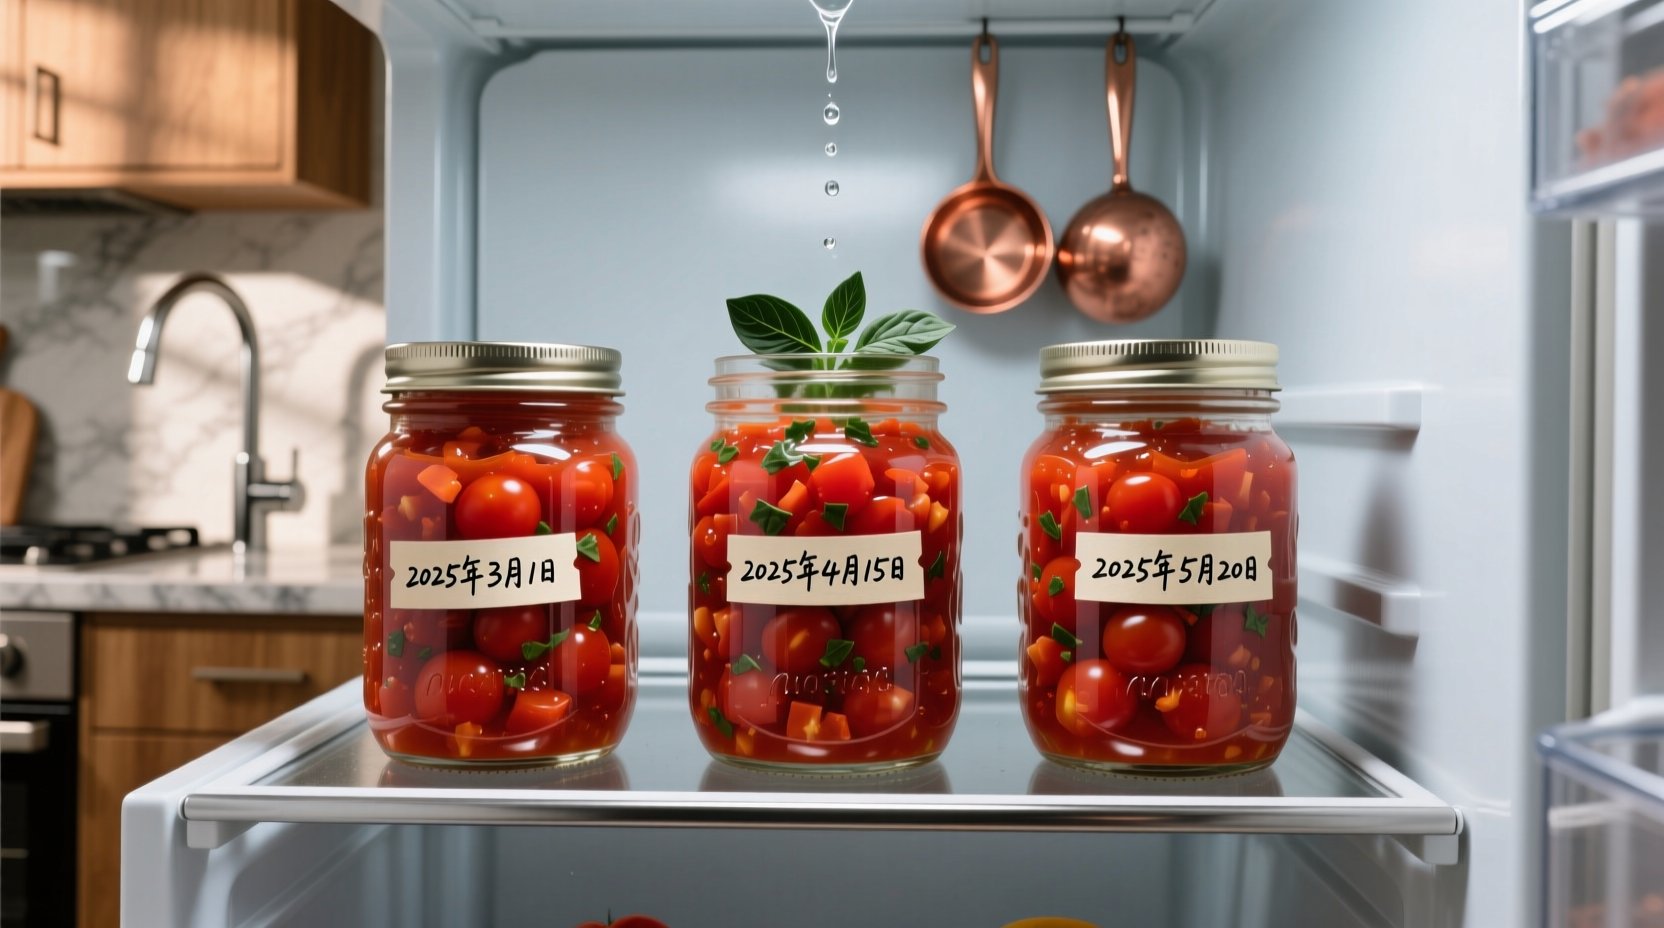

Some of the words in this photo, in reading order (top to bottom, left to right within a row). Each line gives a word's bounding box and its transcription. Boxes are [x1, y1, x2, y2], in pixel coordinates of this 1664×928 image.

[406, 555, 555, 596] 2025年3月1日
[740, 550, 904, 592] 2025年4月15日
[1092, 549, 1257, 592] 2025年5月20日
